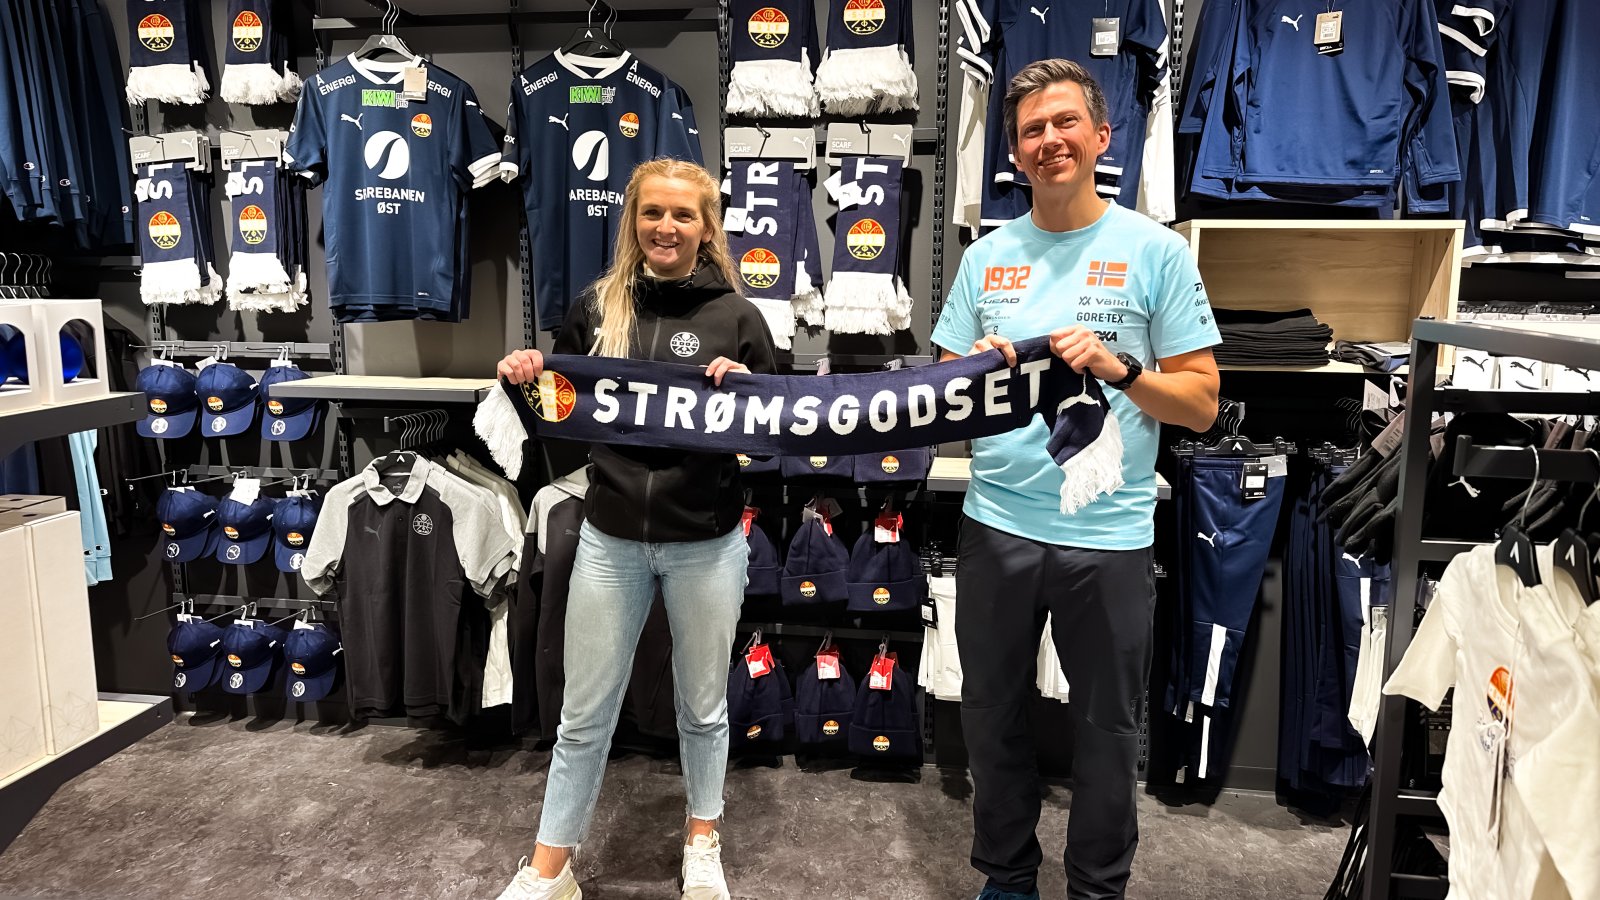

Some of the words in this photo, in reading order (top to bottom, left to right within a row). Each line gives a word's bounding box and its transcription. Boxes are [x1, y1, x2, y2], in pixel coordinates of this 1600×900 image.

[629, 60, 639, 73] Å
[315, 73, 325, 86] Å
[318, 74, 357, 96] ENERGI
[520, 74, 529, 87] Å
[523, 71, 558, 96] ENERGI
[625, 71, 661, 99] ENERGI
[362, 89, 395, 107] KIWI
[427, 80, 452, 98] ERGI
[570, 85, 602, 103] KIWI
[377, 201, 402, 215] ØST
[587, 204, 609, 217] ØST
[983, 265, 1031, 292] 1932
[983, 297, 1020, 305] HEAD
[1093, 330, 1118, 342] OKA
[592, 358, 1051, 435] STRØMSGODSET
